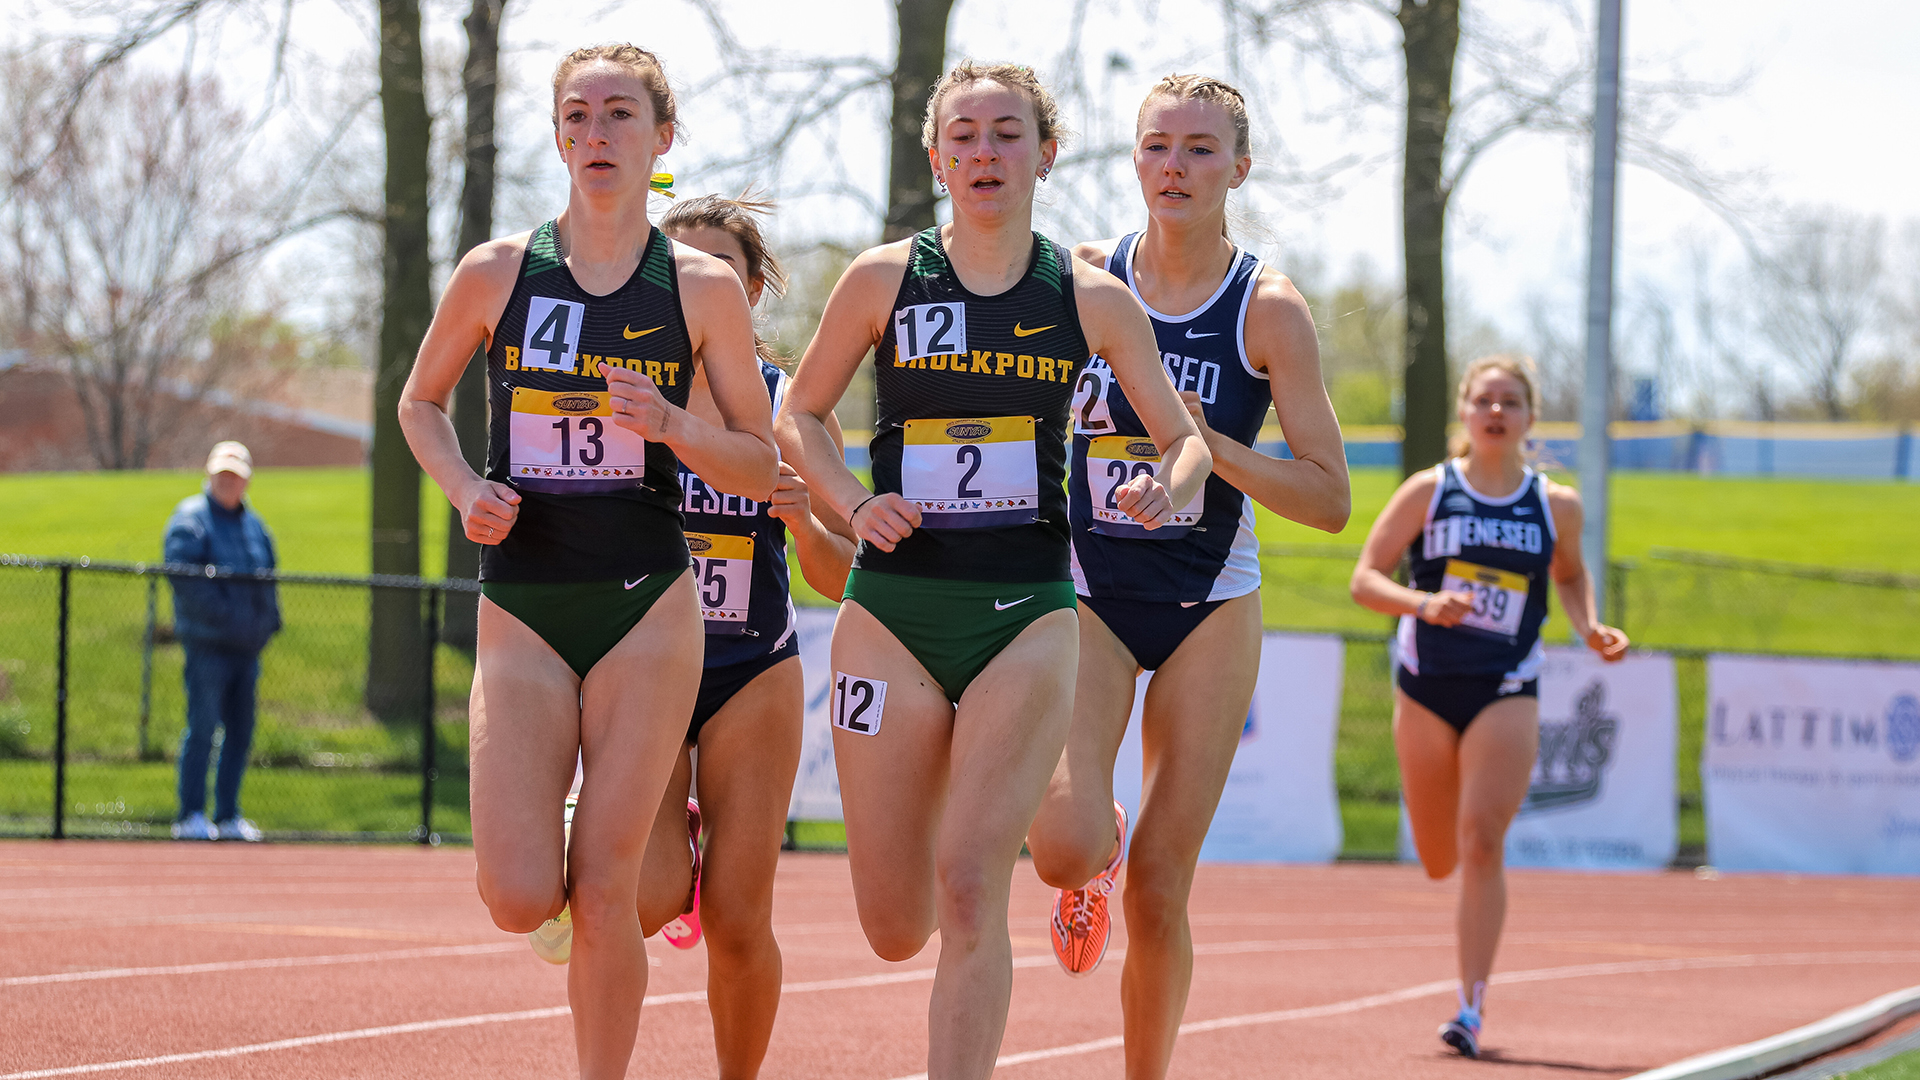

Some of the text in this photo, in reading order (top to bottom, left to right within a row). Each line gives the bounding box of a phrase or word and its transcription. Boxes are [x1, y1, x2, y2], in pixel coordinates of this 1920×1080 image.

[529, 303, 571, 365] 4
[898, 305, 956, 357] 12
[505, 345, 680, 387] BKORT
[1076, 373, 1109, 430] 2
[552, 417, 605, 466] 13
[956, 444, 983, 499] 2
[1105, 459, 1155, 509] 2
[1460, 515, 1542, 555] ENESEO
[837, 675, 875, 733] 12
